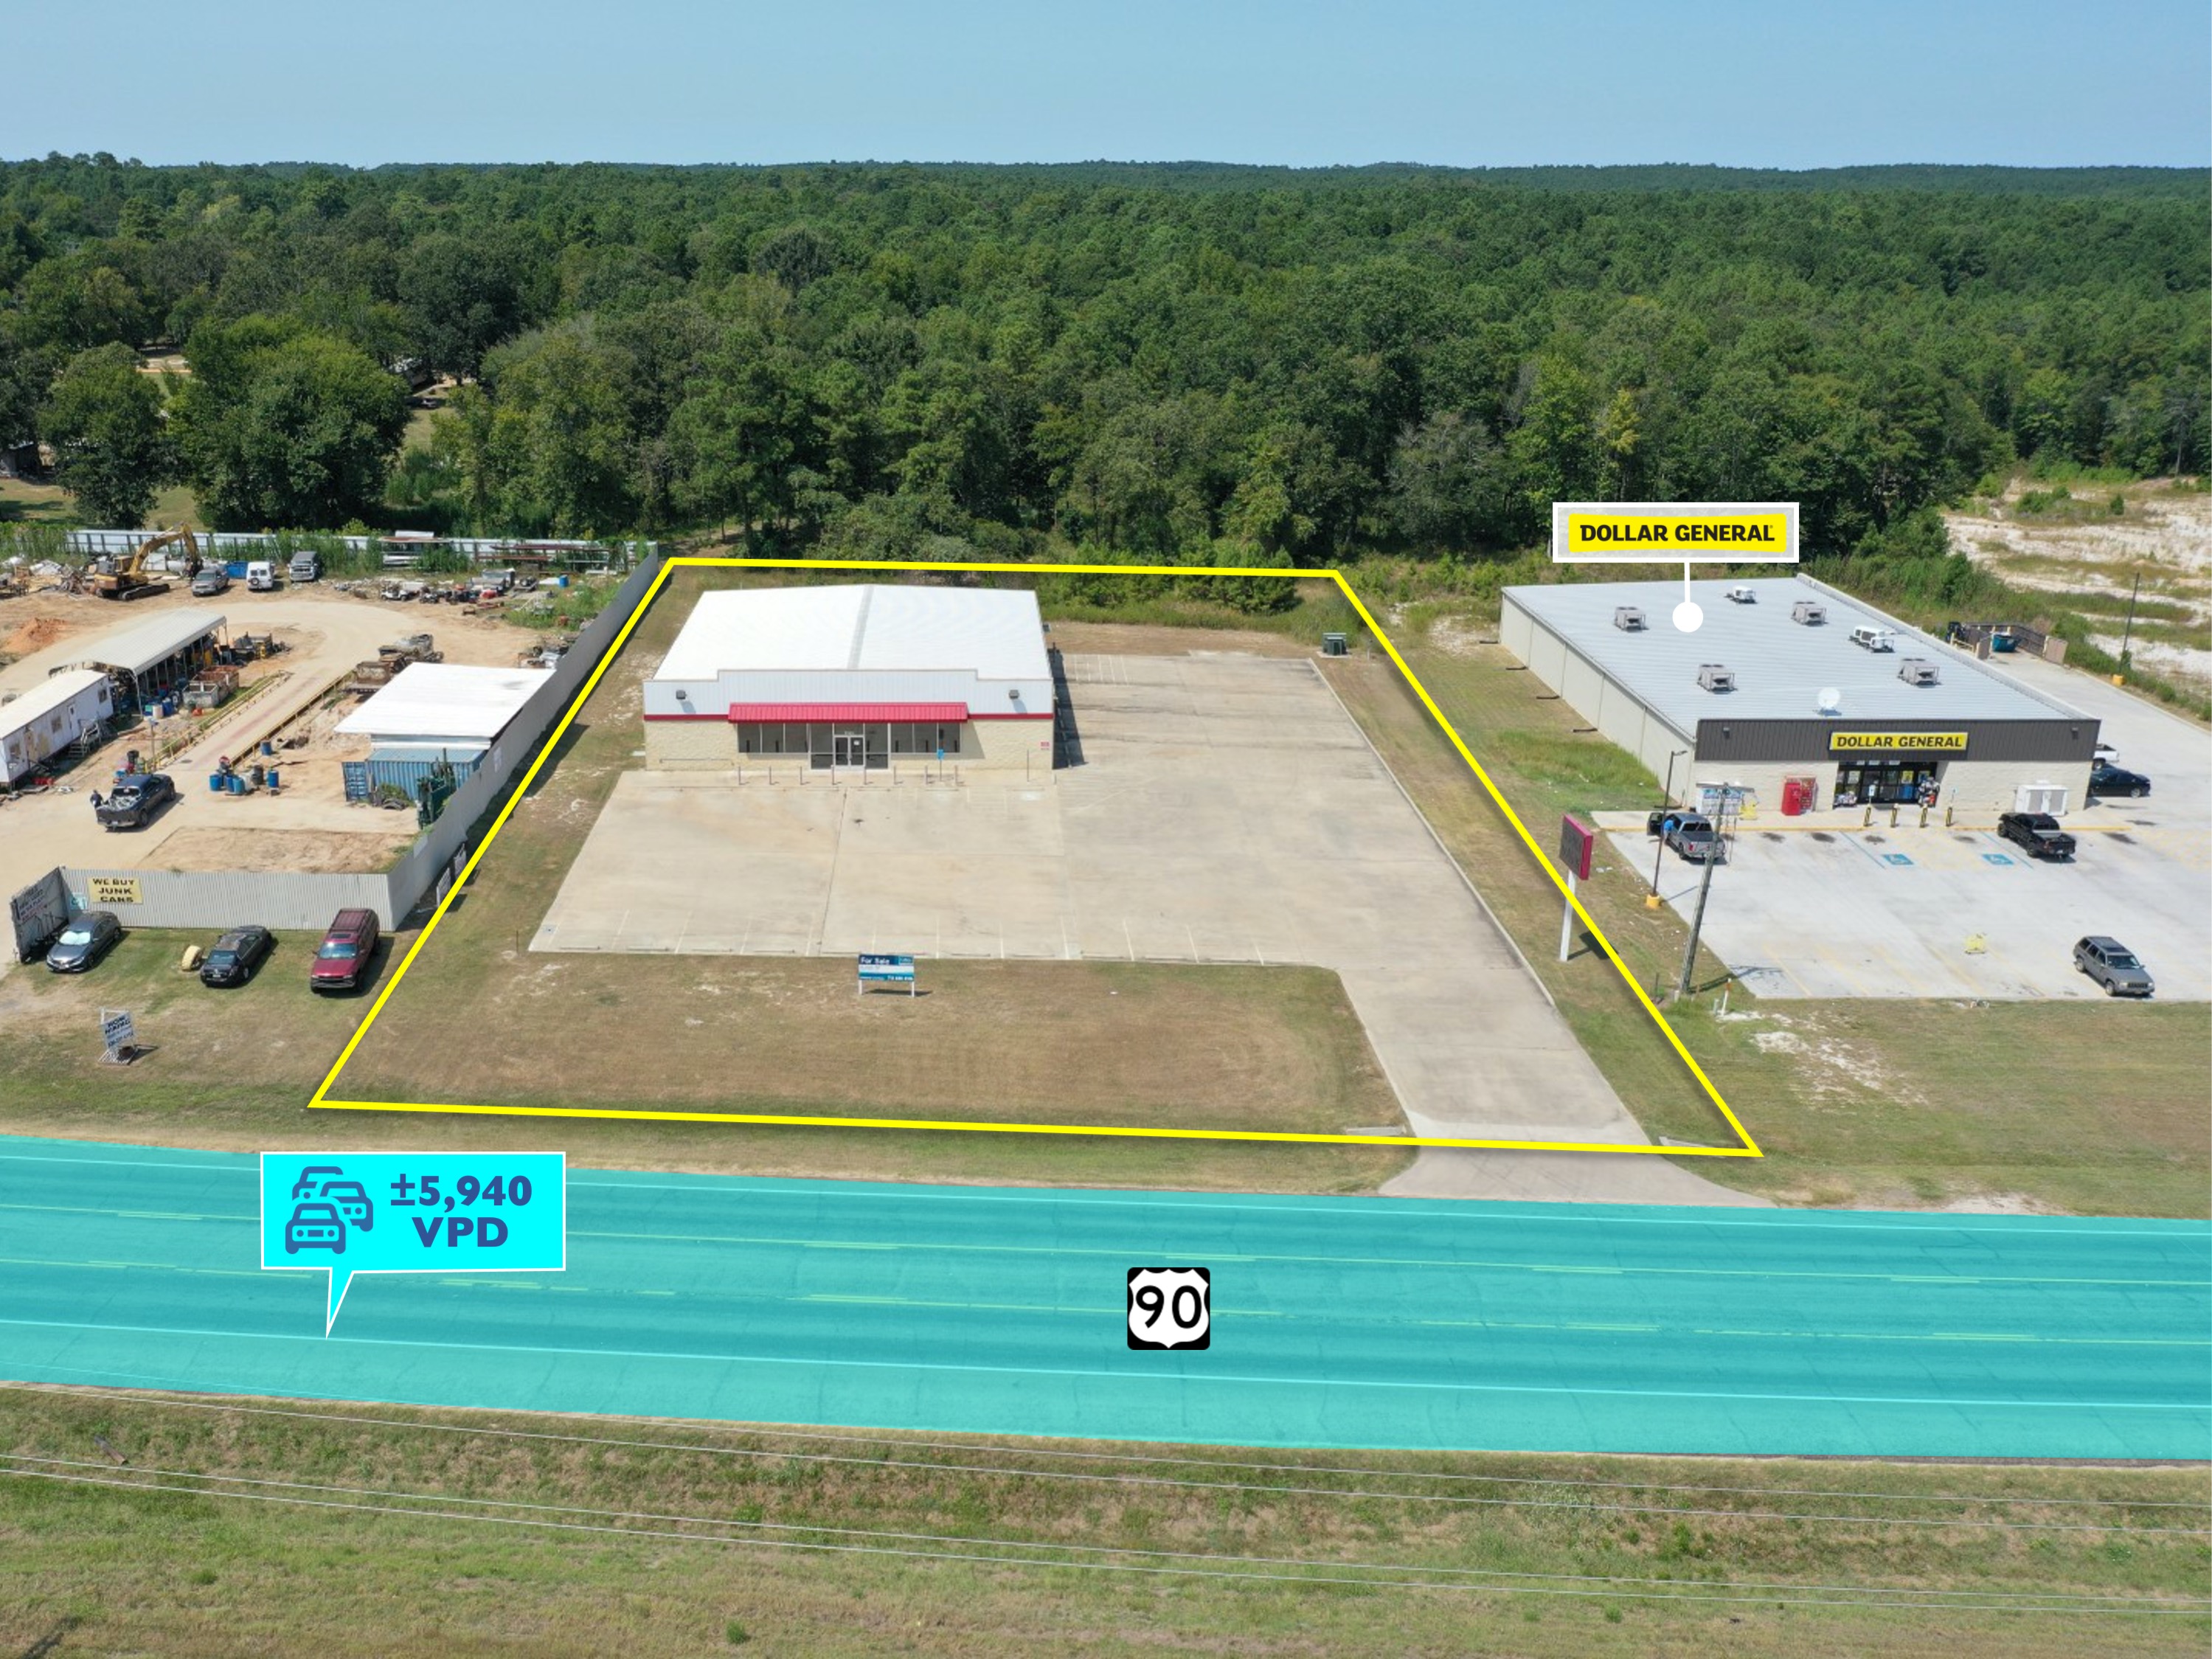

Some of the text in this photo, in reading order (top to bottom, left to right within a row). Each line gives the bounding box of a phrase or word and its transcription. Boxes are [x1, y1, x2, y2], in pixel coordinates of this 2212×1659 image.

[1837, 736, 1962, 747] DOLLAR GENERAL
[860, 956, 873, 964] For
